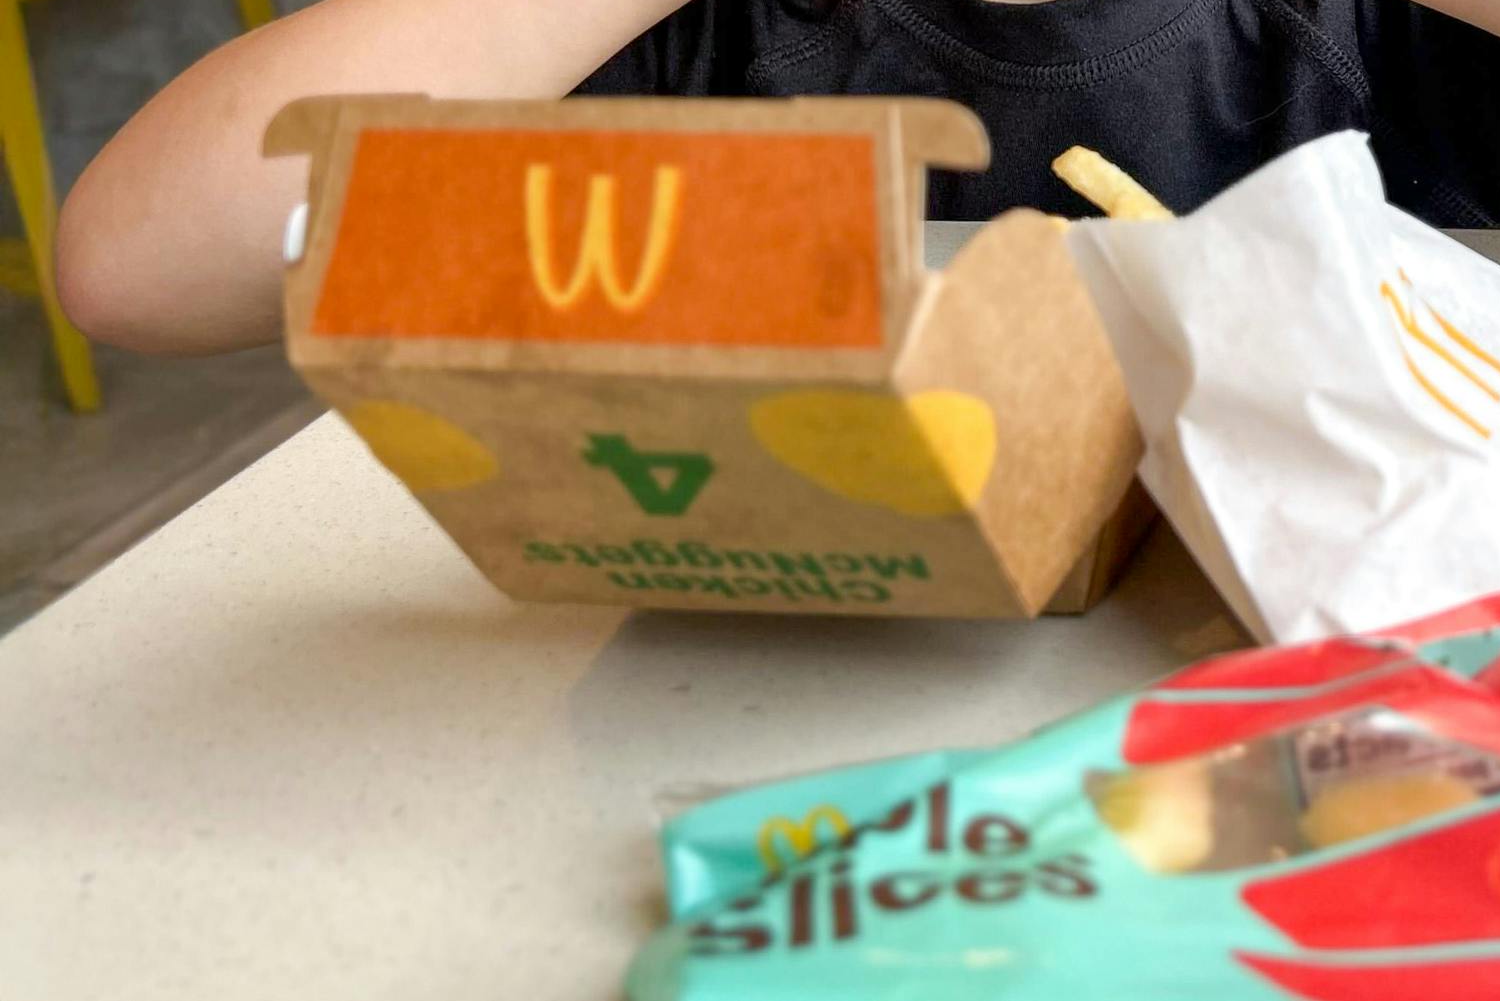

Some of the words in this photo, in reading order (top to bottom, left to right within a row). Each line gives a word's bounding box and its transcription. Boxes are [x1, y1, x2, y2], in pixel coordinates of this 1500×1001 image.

[582, 433, 715, 517] 4
[522, 540, 931, 580] McNuggets
[607, 571, 892, 602] Chicken
[690, 852, 1098, 955] slices
